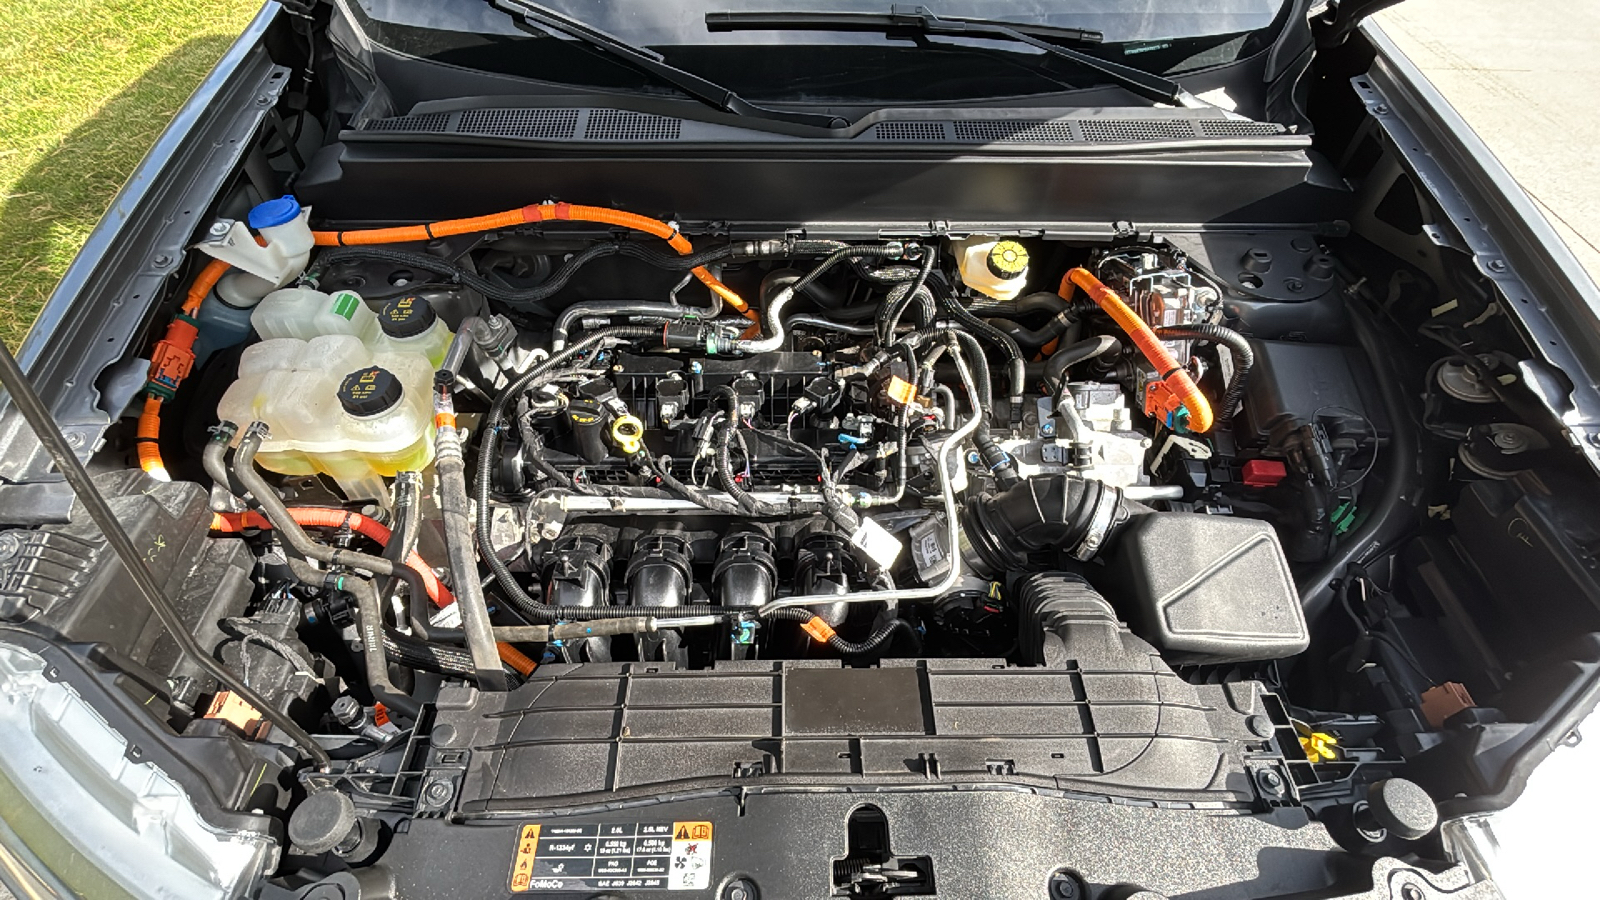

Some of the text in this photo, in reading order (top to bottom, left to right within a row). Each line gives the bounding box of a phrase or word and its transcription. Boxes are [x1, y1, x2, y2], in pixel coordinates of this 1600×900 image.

[656, 825, 669, 833] HEV
[620, 840, 627, 848] kg
[530, 879, 564, 889] FoMoCo
